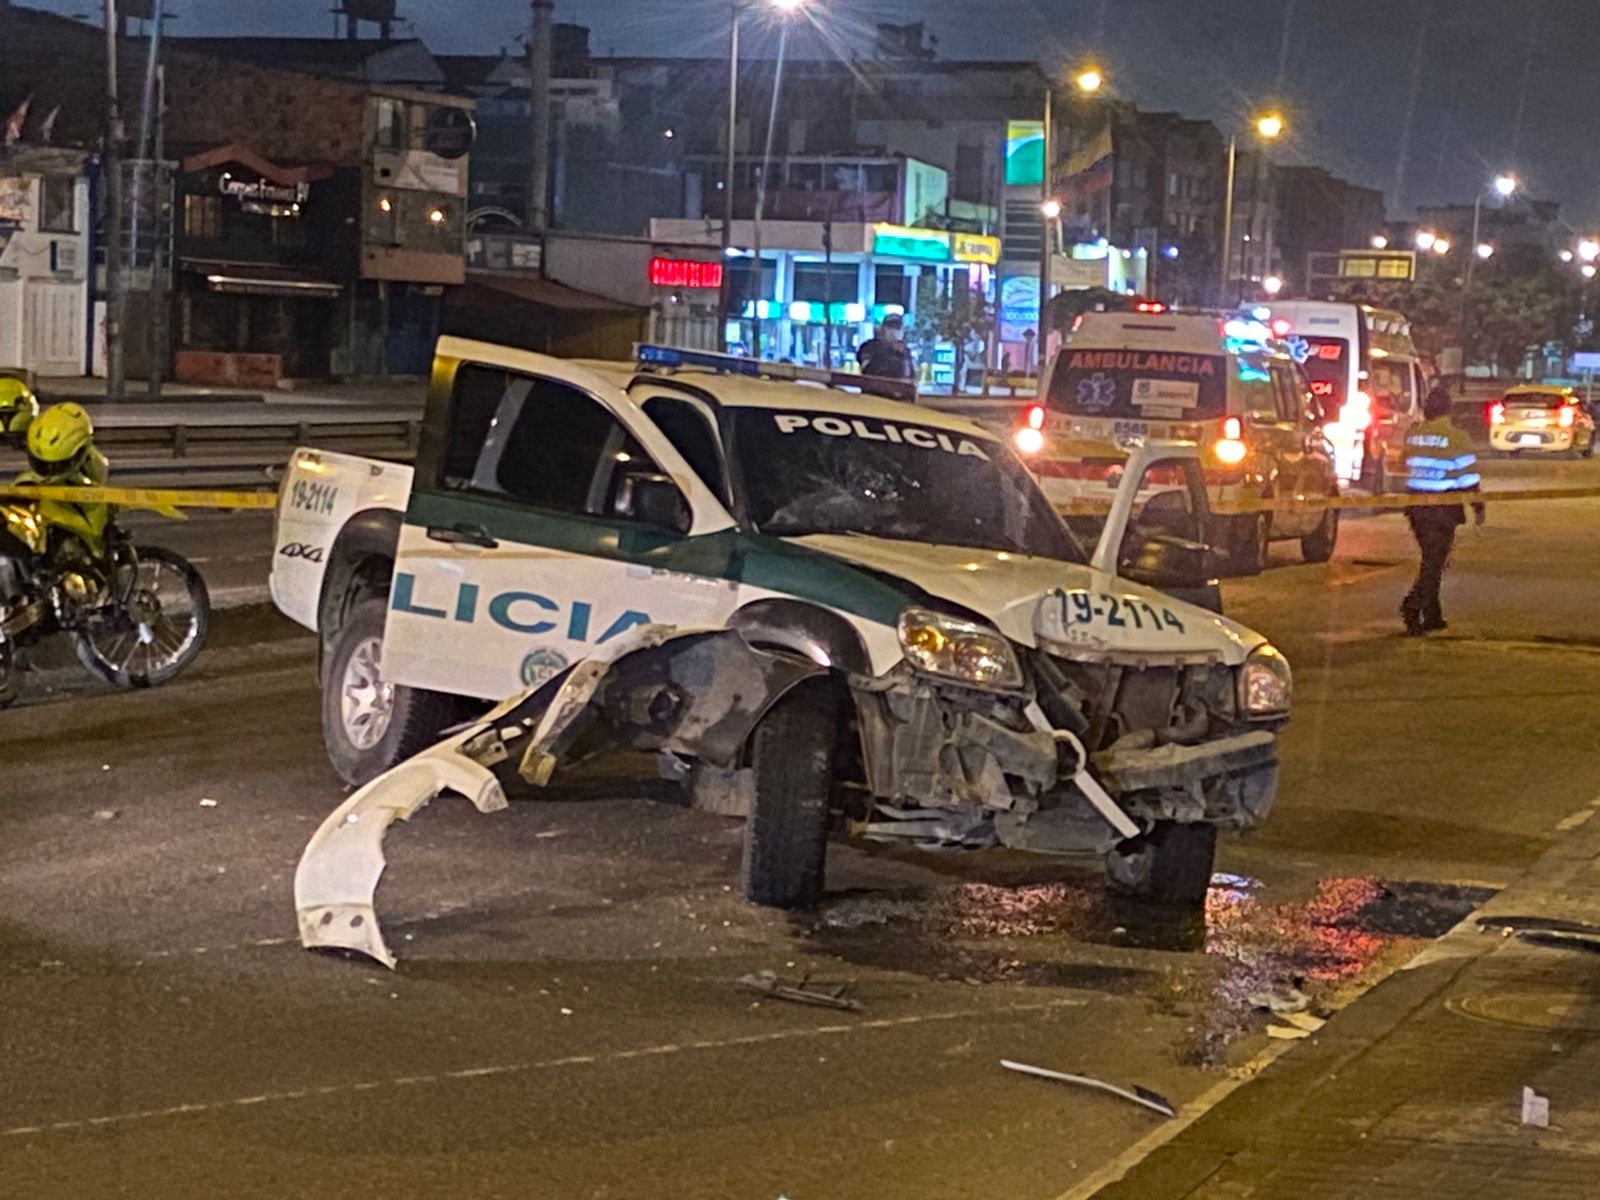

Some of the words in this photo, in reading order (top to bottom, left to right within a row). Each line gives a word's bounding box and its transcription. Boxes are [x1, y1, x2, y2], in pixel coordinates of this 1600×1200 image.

[1070, 351, 1215, 376] AMBULANCIA
[774, 414, 992, 462] POLICIA
[290, 479, 339, 517] 19-2114
[1053, 587, 1186, 634] 19-2114
